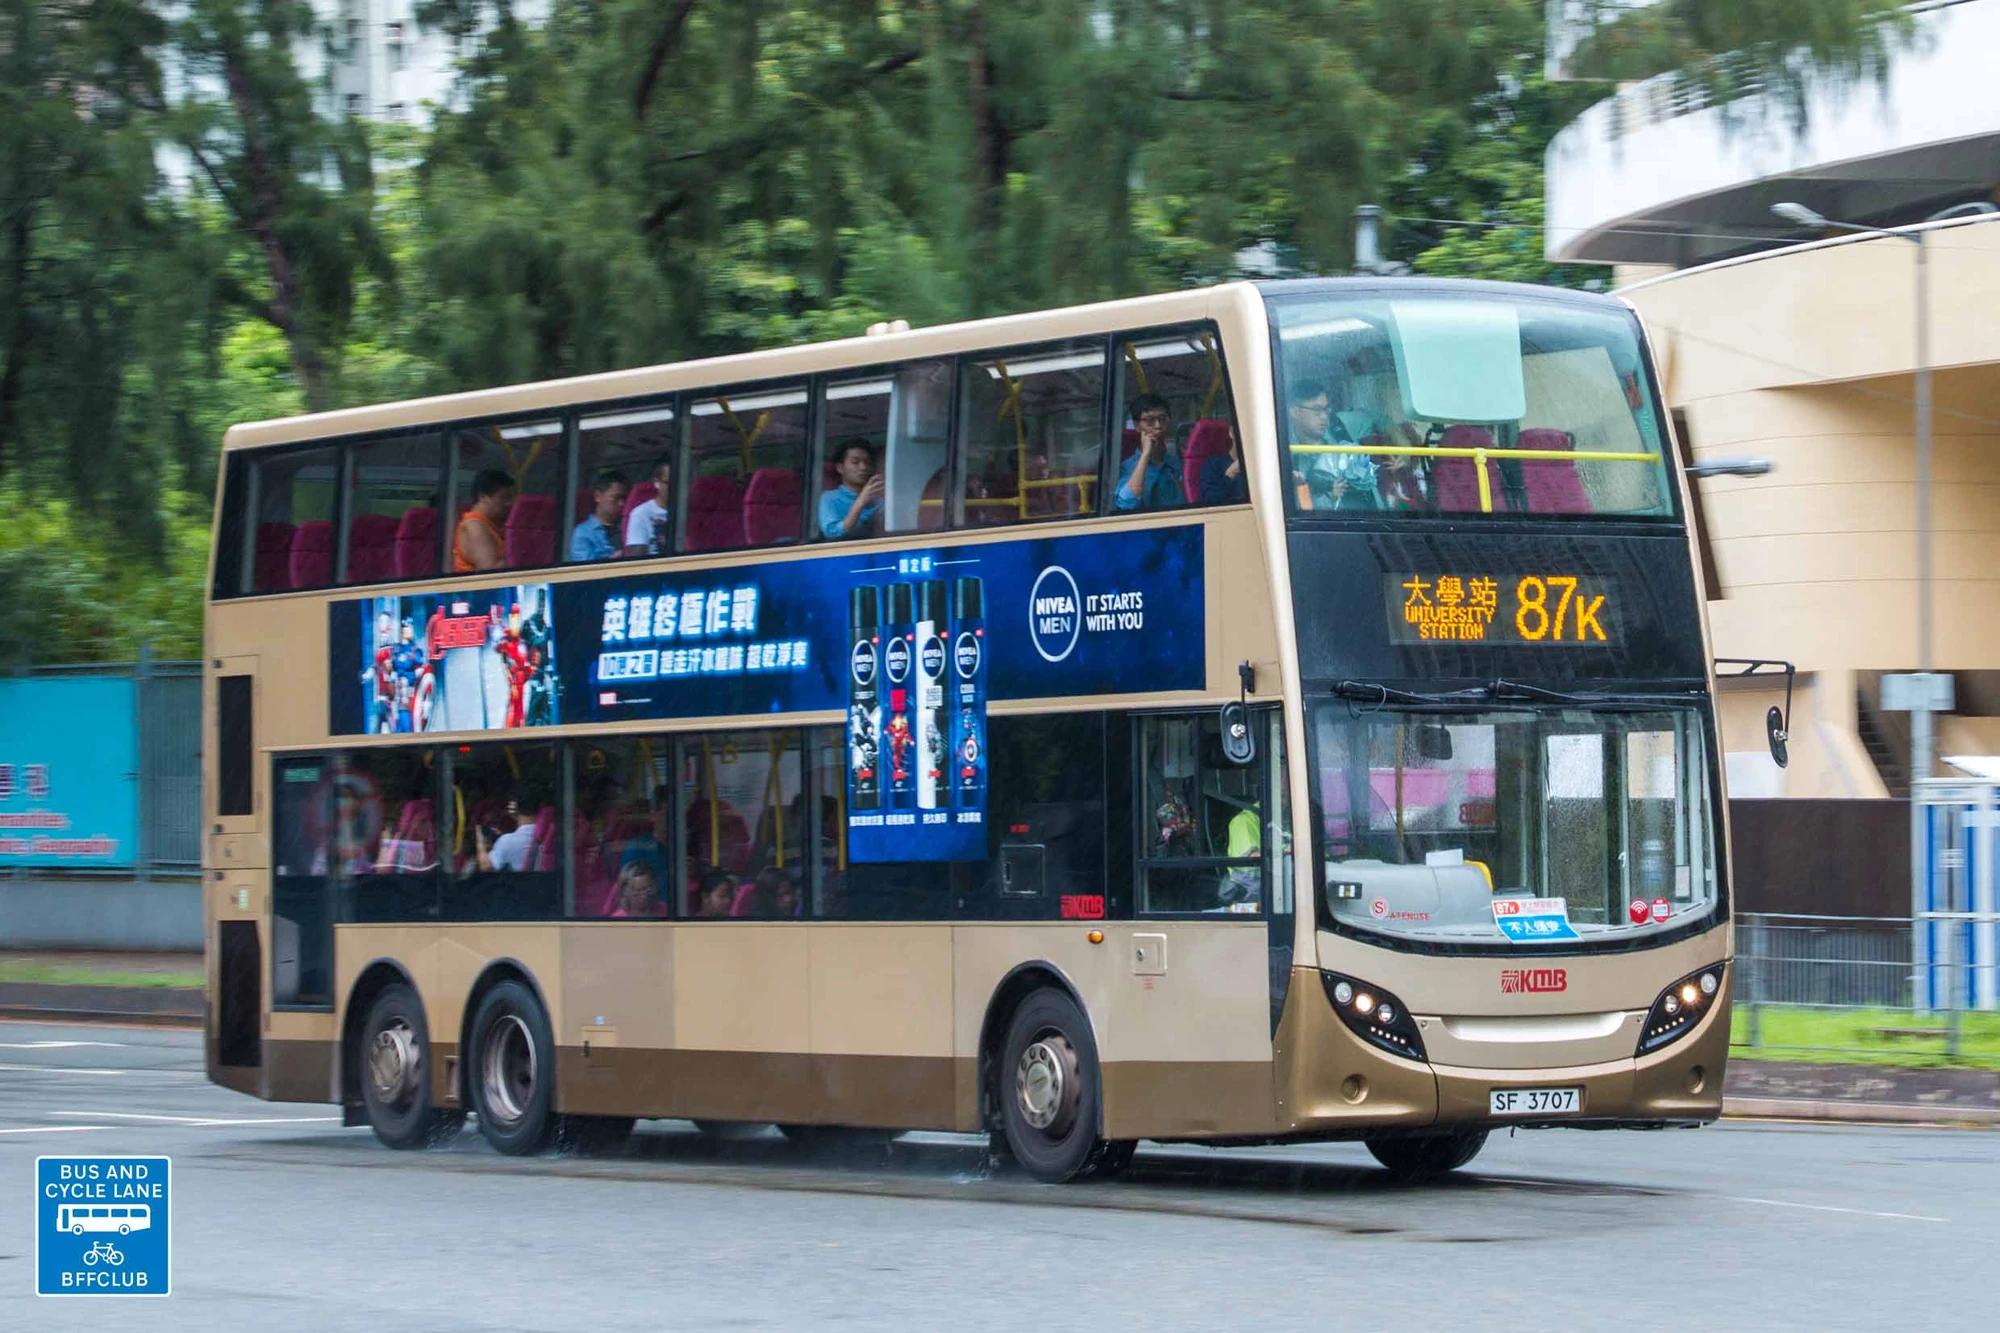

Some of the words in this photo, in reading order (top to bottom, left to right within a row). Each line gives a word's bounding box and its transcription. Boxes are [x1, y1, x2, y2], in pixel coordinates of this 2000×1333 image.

[1402, 574, 1498, 606] 大學站
[1036, 596, 1076, 615] NIVEA
[1086, 594, 1099, 612] IT
[1100, 591, 1144, 612] STARTS
[1516, 576, 1607, 641] 87K
[1086, 614, 1116, 632] WITH
[1117, 611, 1144, 631] YOU
[1405, 606, 1496, 624] UNIVERSITY
[1039, 616, 1071, 635] MEN
[1419, 622, 1484, 640] STATION
[1496, 902, 1516, 914] 87K
[1520, 969, 1567, 993] KMB
[1496, 1093, 1518, 1110] SF
[1528, 1091, 1574, 1110] 3707
